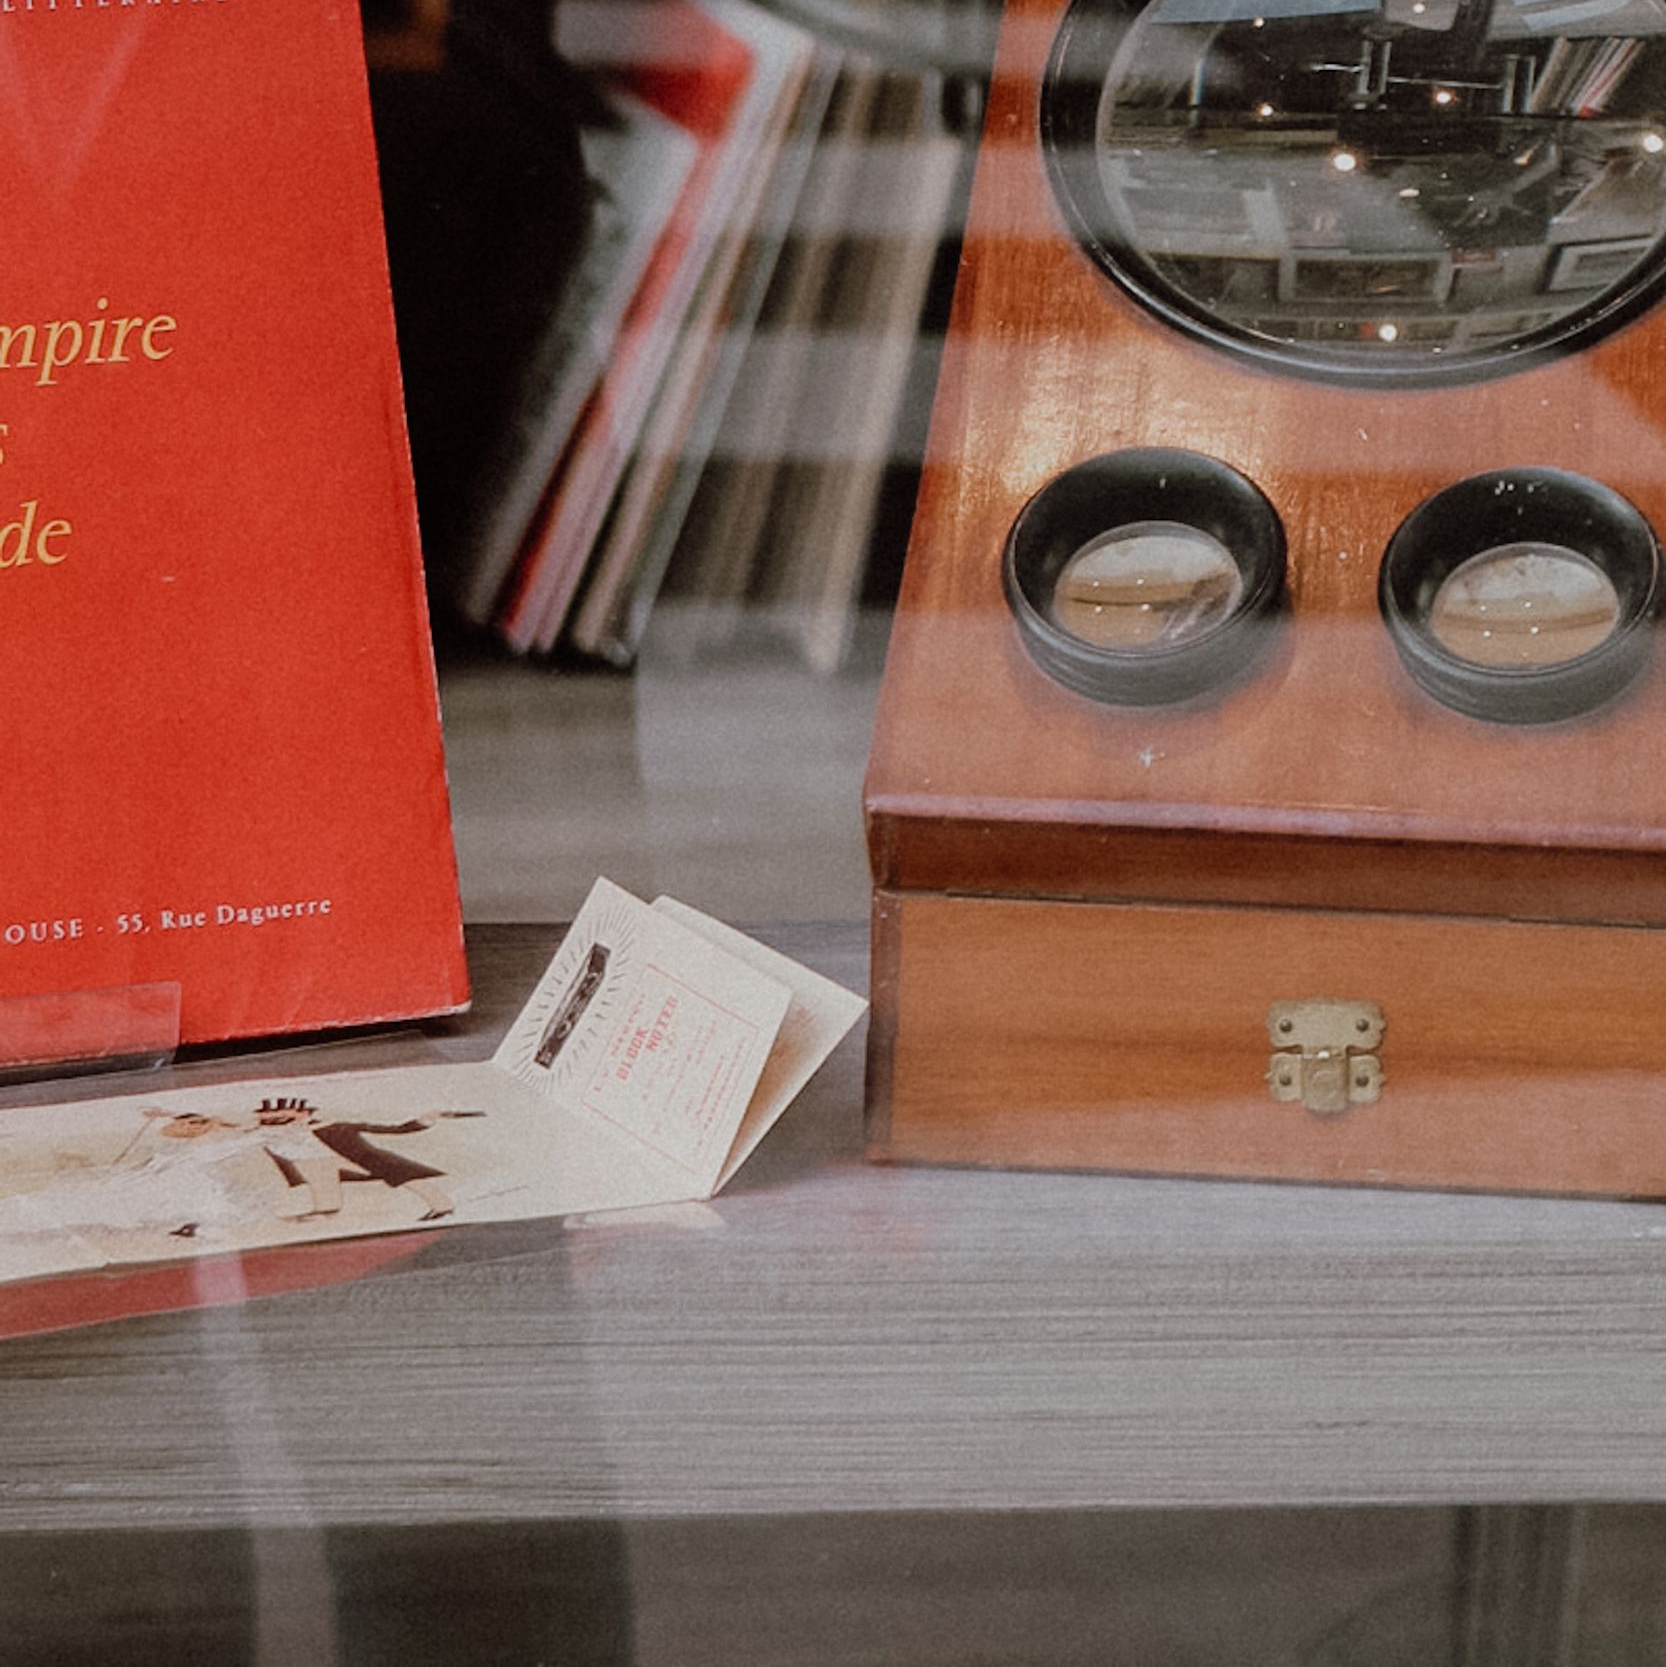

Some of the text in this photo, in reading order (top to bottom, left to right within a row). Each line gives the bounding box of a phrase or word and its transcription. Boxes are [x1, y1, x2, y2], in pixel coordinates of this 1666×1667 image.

[4, 918, 84, 944] OUSE
[117, 913, 151, 934] 55,
[160, 910, 206, 930] Rue
[216, 899, 333, 926] Daguerre
